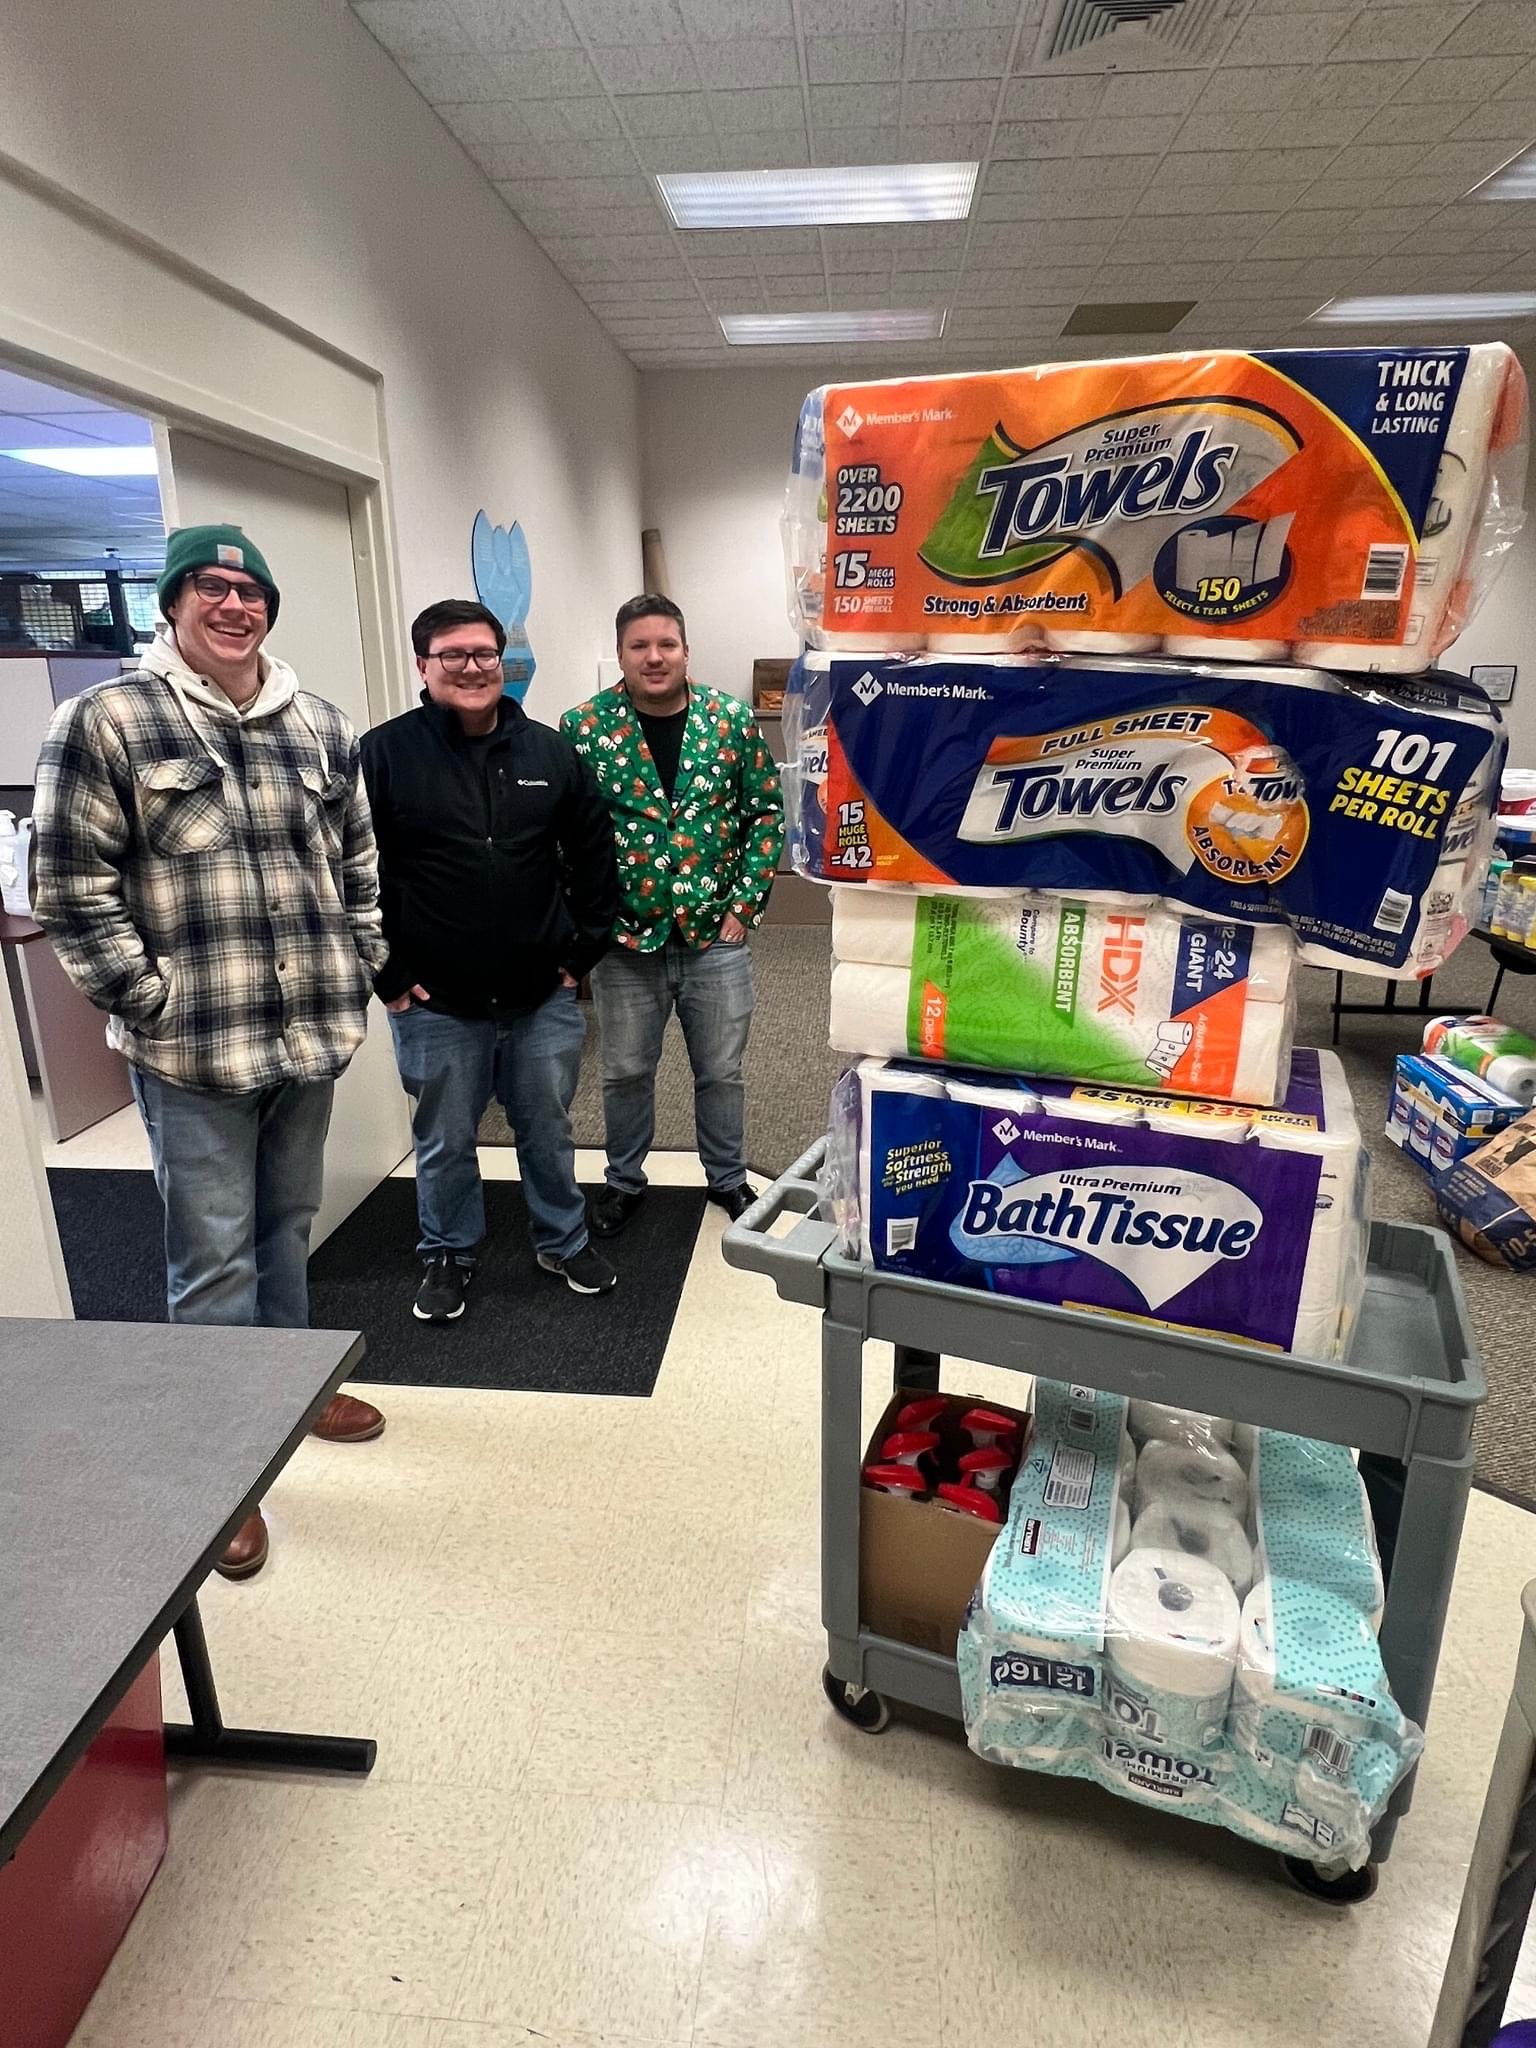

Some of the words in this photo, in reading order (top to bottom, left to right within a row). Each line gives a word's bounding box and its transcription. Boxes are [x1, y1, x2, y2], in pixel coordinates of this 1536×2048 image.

[1377, 360, 1456, 388] THICK
[1375, 393, 1390, 411] &
[1394, 392, 1446, 412] LONG
[865, 410, 921, 427] Member's
[921, 407, 953, 423] Mark
[1371, 417, 1440, 434] LASTING
[1101, 422, 1161, 445] Super
[1083, 436, 1172, 463] Premium
[837, 467, 878, 485] OVER
[836, 485, 902, 514] 2200
[976, 424, 1240, 560] Towels
[836, 515, 896, 535] SHEETS
[833, 552, 869, 588] 15
[868, 567, 895, 579] MEGA
[867, 578, 896, 589] ROLLS
[1196, 577, 1242, 602] 150
[833, 595, 862, 613] 150
[923, 593, 981, 616] Strong
[983, 594, 997, 613] &
[998, 591, 1088, 615] Absorbent
[1163, 590, 1194, 614] SELECT
[1202, 605, 1229, 616] TEAR
[1232, 590, 1270, 613] SHEETS
[887, 682, 951, 699] Member's
[952, 685, 987, 700] Mark
[1041, 727, 1104, 754] FULL
[1111, 711, 1211, 736] SHEET
[1074, 758, 1142, 771] Premium
[1089, 748, 1136, 761] Super
[1370, 729, 1457, 782] 101
[991, 761, 1188, 837] Towels
[1336, 767, 1451, 817] SHEETS
[838, 801, 865, 824] 15
[1329, 794, 1377, 823] PER
[1378, 806, 1440, 840] ROLL
[838, 824, 866, 836] HUGE
[838, 834, 868, 847] ROLLS
[1192, 825, 1293, 879] ABSORBENT
[1017, 908, 1032, 953] Bounty
[1028, 908, 1040, 945] Compare
[1054, 911, 1081, 1013] ABSORBENT
[1097, 915, 1147, 1017] HDX
[1185, 933, 1207, 993] GIANT
[925, 996, 942, 1018] 12
[1195, 1104, 1255, 1118] 235
[886, 1140, 942, 1161] Superior
[1023, 1129, 1082, 1147] Member's
[1084, 1138, 1118, 1152] Mark
[885, 1151, 950, 1175] Softness
[895, 1161, 952, 1184] Strength
[895, 1182, 913, 1196] you
[915, 1175, 939, 1188] need
[1058, 1173, 1100, 1189] Ultra
[1101, 1178, 1182, 1197] Premium
[1056, 1672, 1087, 1691] 12
[1127, 1761, 1189, 1785] PREMIUM
